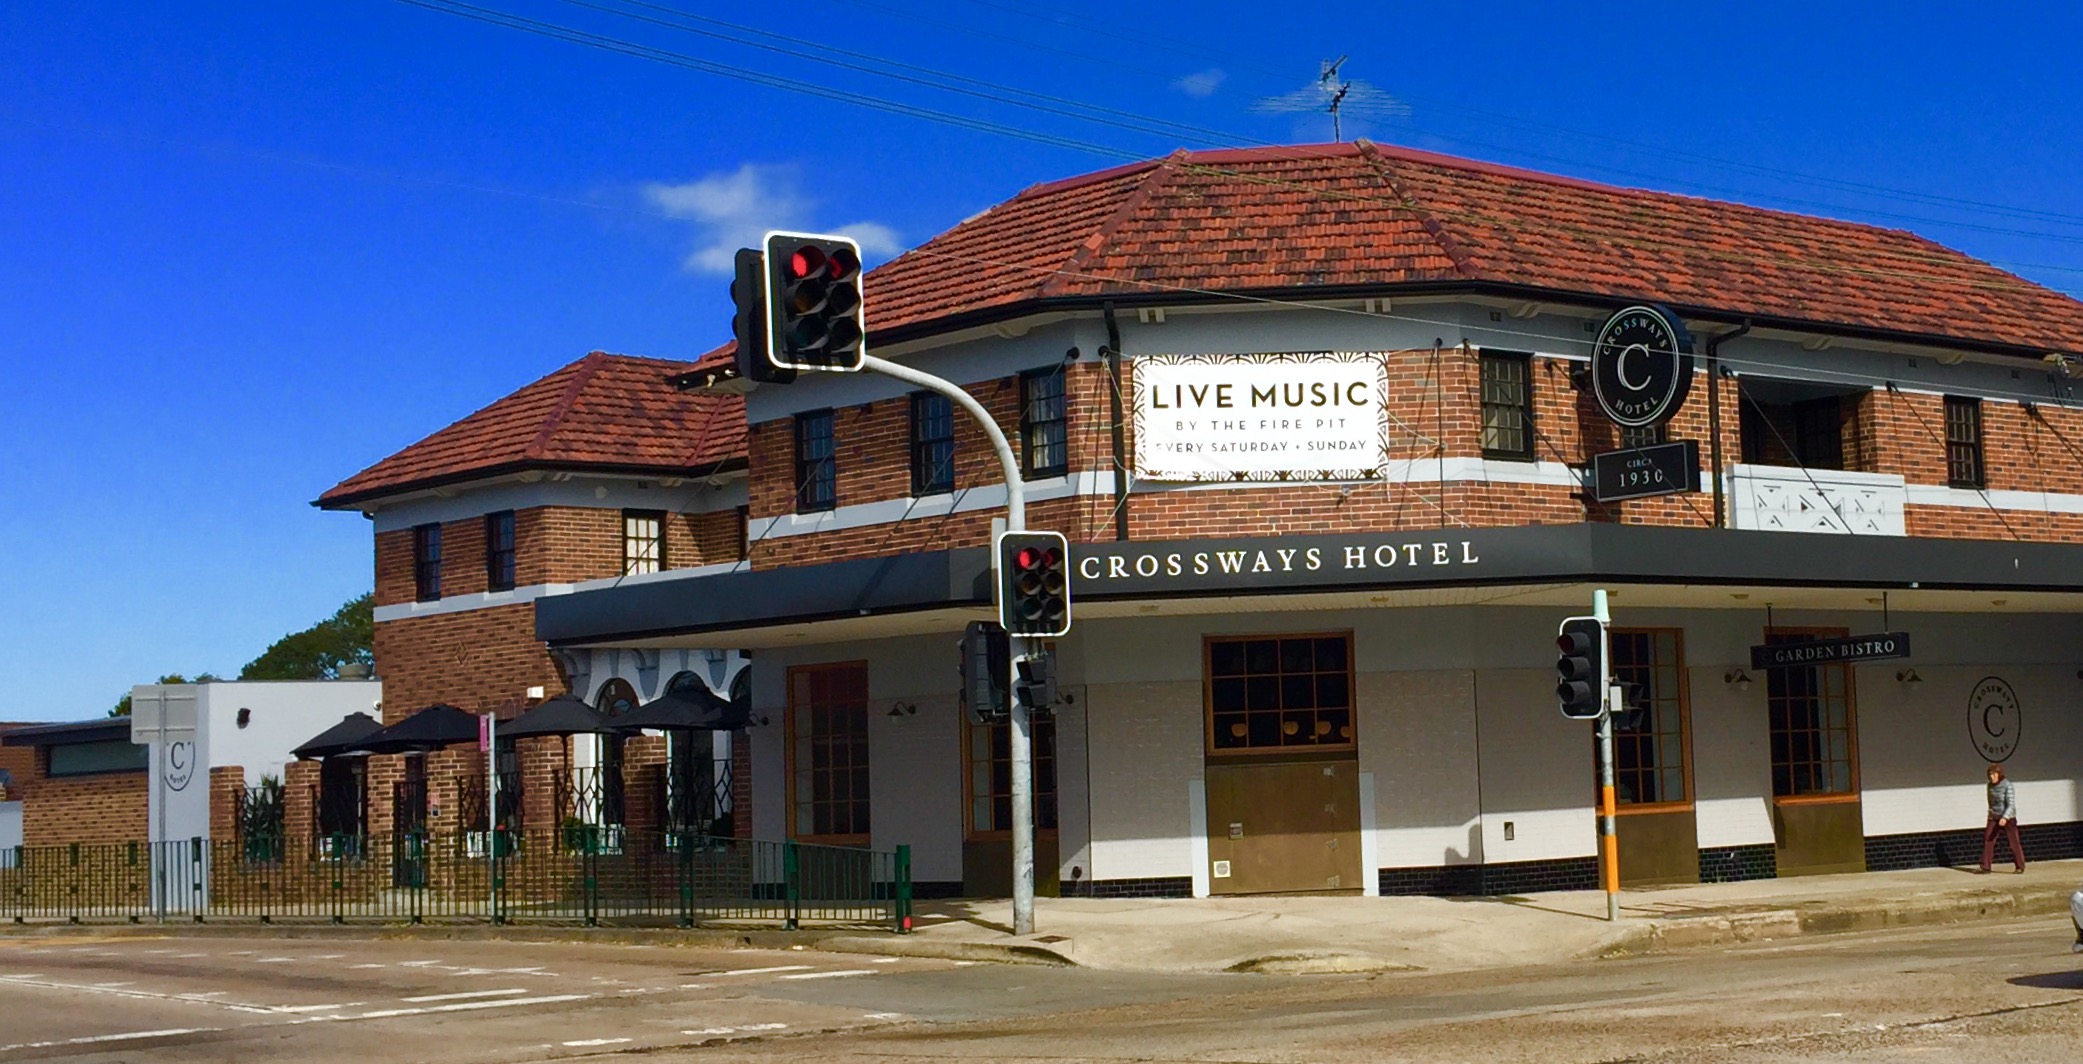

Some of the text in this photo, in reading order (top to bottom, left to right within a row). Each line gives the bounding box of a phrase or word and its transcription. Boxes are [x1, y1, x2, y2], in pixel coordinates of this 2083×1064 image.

[1603, 318, 1668, 355] CROSSWAYS
[1617, 343, 1652, 391] C
[1152, 381, 1369, 409] LIVE MUSIC
[1615, 397, 1658, 414] HOTEL
[1176, 418, 1347, 431] BY THE FIRE PIT
[1211, 441, 1288, 452] SATURDAY
[1308, 439, 1367, 451] SUNDAY
[1620, 469, 1664, 487] 1930
[1080, 541, 1479, 580] CROSSWAYS HOTEL
[1775, 645, 1835, 663] GARDEN
[1841, 640, 1895, 657] BISTRO
[1983, 704, 2005, 737] C
[171, 741, 184, 769] C
